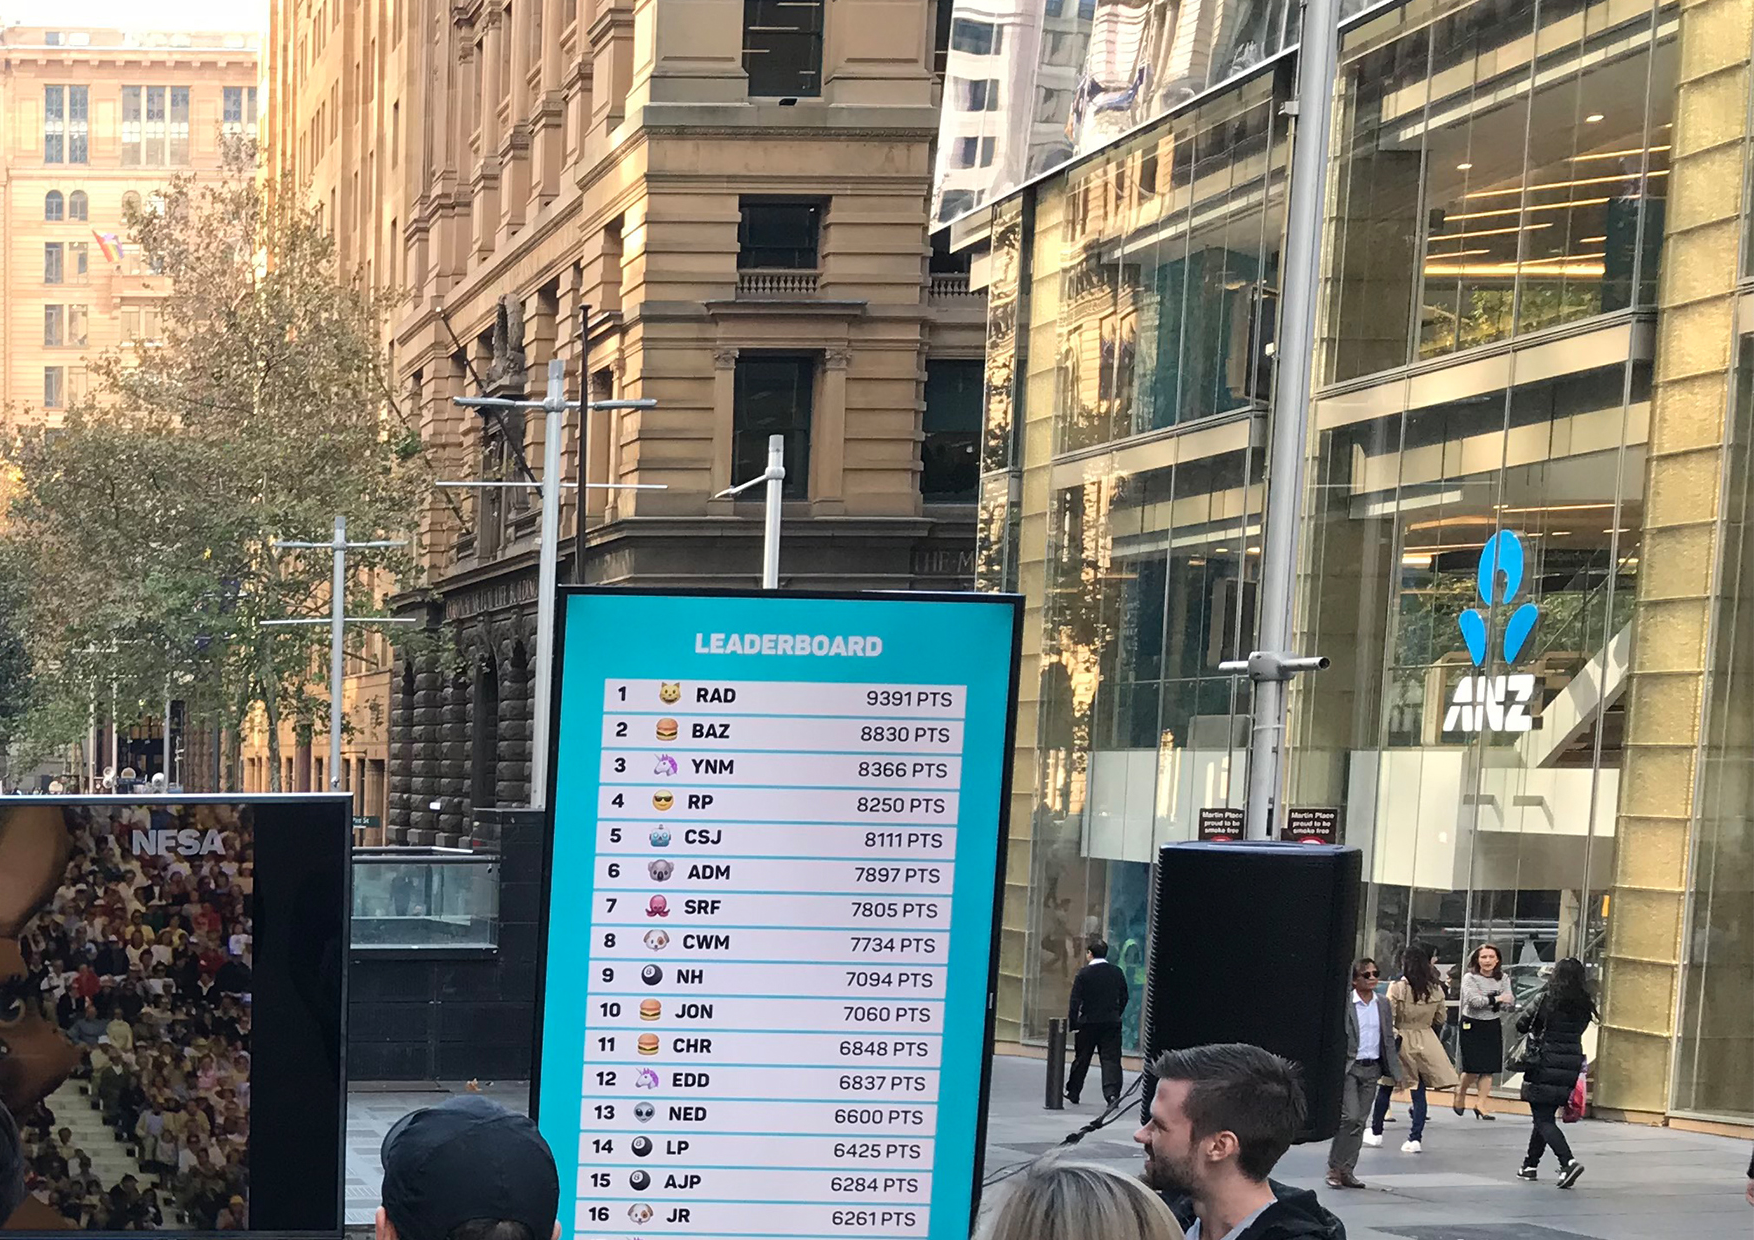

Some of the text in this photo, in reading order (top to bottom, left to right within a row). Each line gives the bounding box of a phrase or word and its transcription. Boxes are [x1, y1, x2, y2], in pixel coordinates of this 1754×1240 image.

[695, 633, 882, 656] LEADERBOARD
[619, 686, 952, 707] 1 RAD 9391 PTS
[1443, 674, 1535, 731] ANZ
[616, 722, 949, 743] 2 BAZ 8830 PTS
[615, 758, 947, 778] 3 YNM 8366 PTS
[612, 793, 944, 813] 4 RP 8250 PTS
[132, 829, 226, 856] NFSA
[610, 828, 942, 848] 5 CSJ 8111 PTS
[608, 863, 940, 883] 6 ADM 7897 PTS
[606, 899, 937, 918] 7 SRF 7805 PTS
[604, 933, 935, 953] 8 CWM 7734 PTS
[603, 968, 932, 987] 9 NH 7094 PTS
[600, 1003, 930, 1022] 10 JON 7060 PTS
[598, 1037, 928, 1056] 11 CHR 6848 PTS
[597, 1072, 925, 1091] 12 EDD 6837 PTS
[595, 1105, 923, 1125] 13 NED 6600 PTS
[593, 1140, 920, 1159] 14 LP 6425 PTS
[591, 1173, 918, 1192] 15 AJP 6284 PTS
[589, 1207, 915, 1226] 16 JR 6261 PTS
